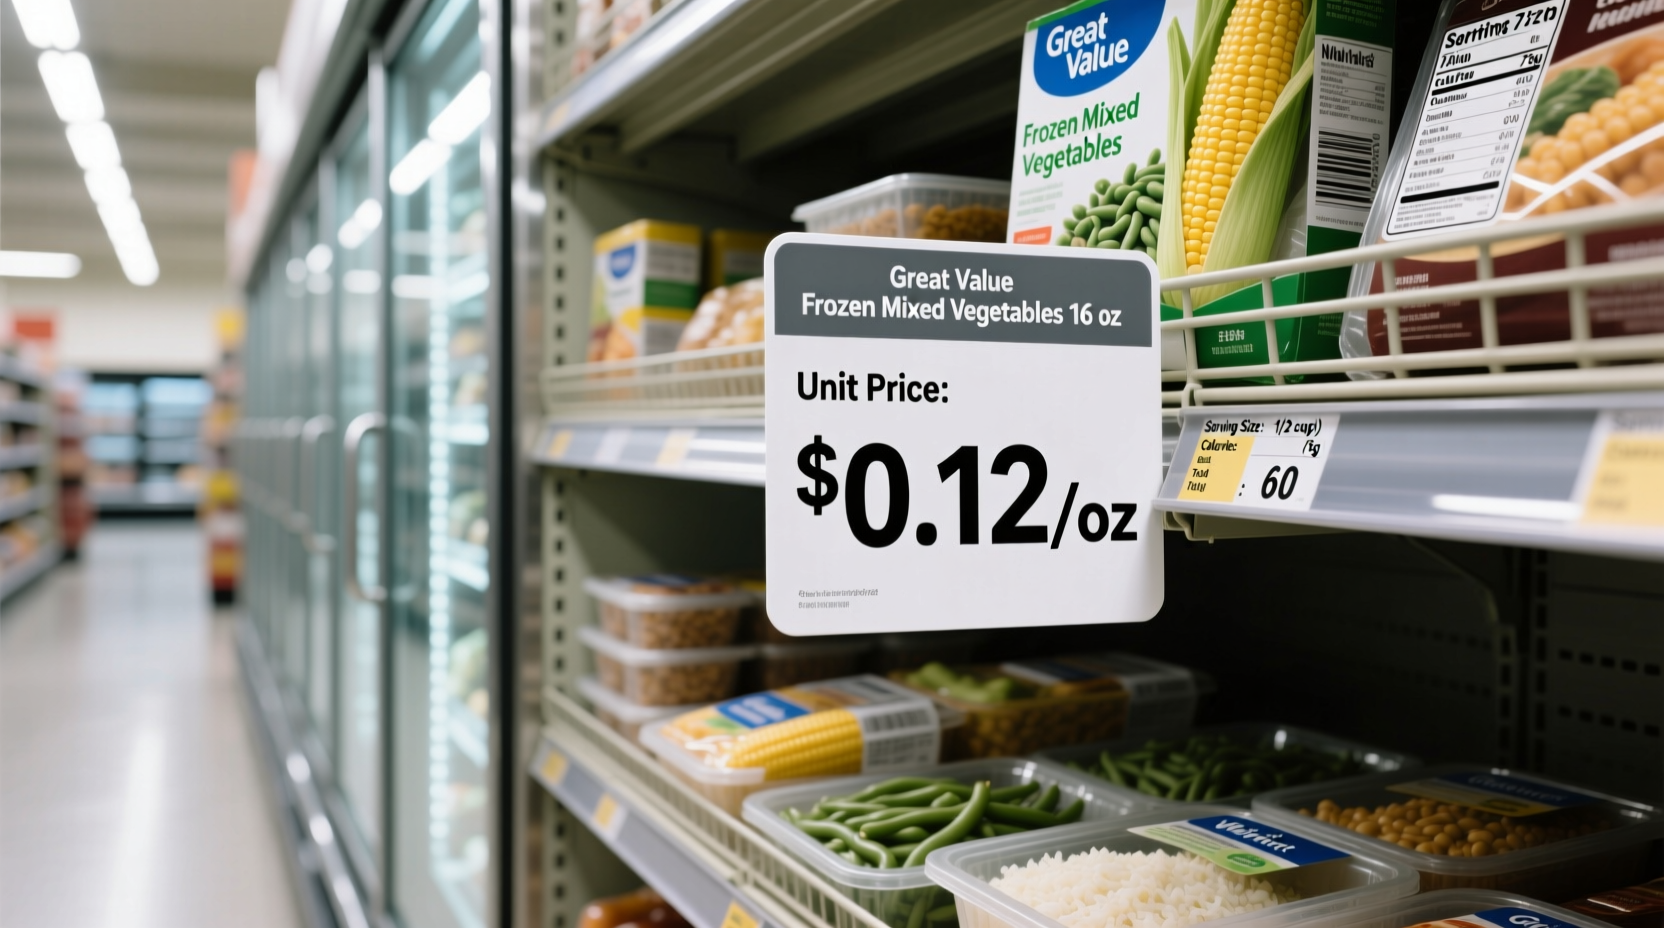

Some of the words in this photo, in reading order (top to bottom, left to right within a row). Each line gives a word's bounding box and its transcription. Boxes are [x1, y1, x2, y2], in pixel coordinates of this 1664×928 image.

[1046, 12, 1109, 58] Great
[1066, 38, 1130, 80] Value
[1023, 116, 1078, 148] Frozen
[1082, 92, 1141, 132] Mixed
[1023, 133, 1123, 179] Vegetables
[890, 265, 950, 291] Great
[955, 268, 1014, 293] Value
[803, 293, 876, 318] Frozen
[882, 295, 945, 321] Mixed
[950, 298, 1064, 328] Vegetables
[1069, 303, 1093, 326] 16
[1098, 308, 1122, 327] oz
[797, 371, 859, 402] Unit
[867, 373, 949, 404] Price:
[1275, 418, 1293, 437] 1/2
[796, 434, 1138, 550] $0.12/oz
[1260, 465, 1299, 501] 60
